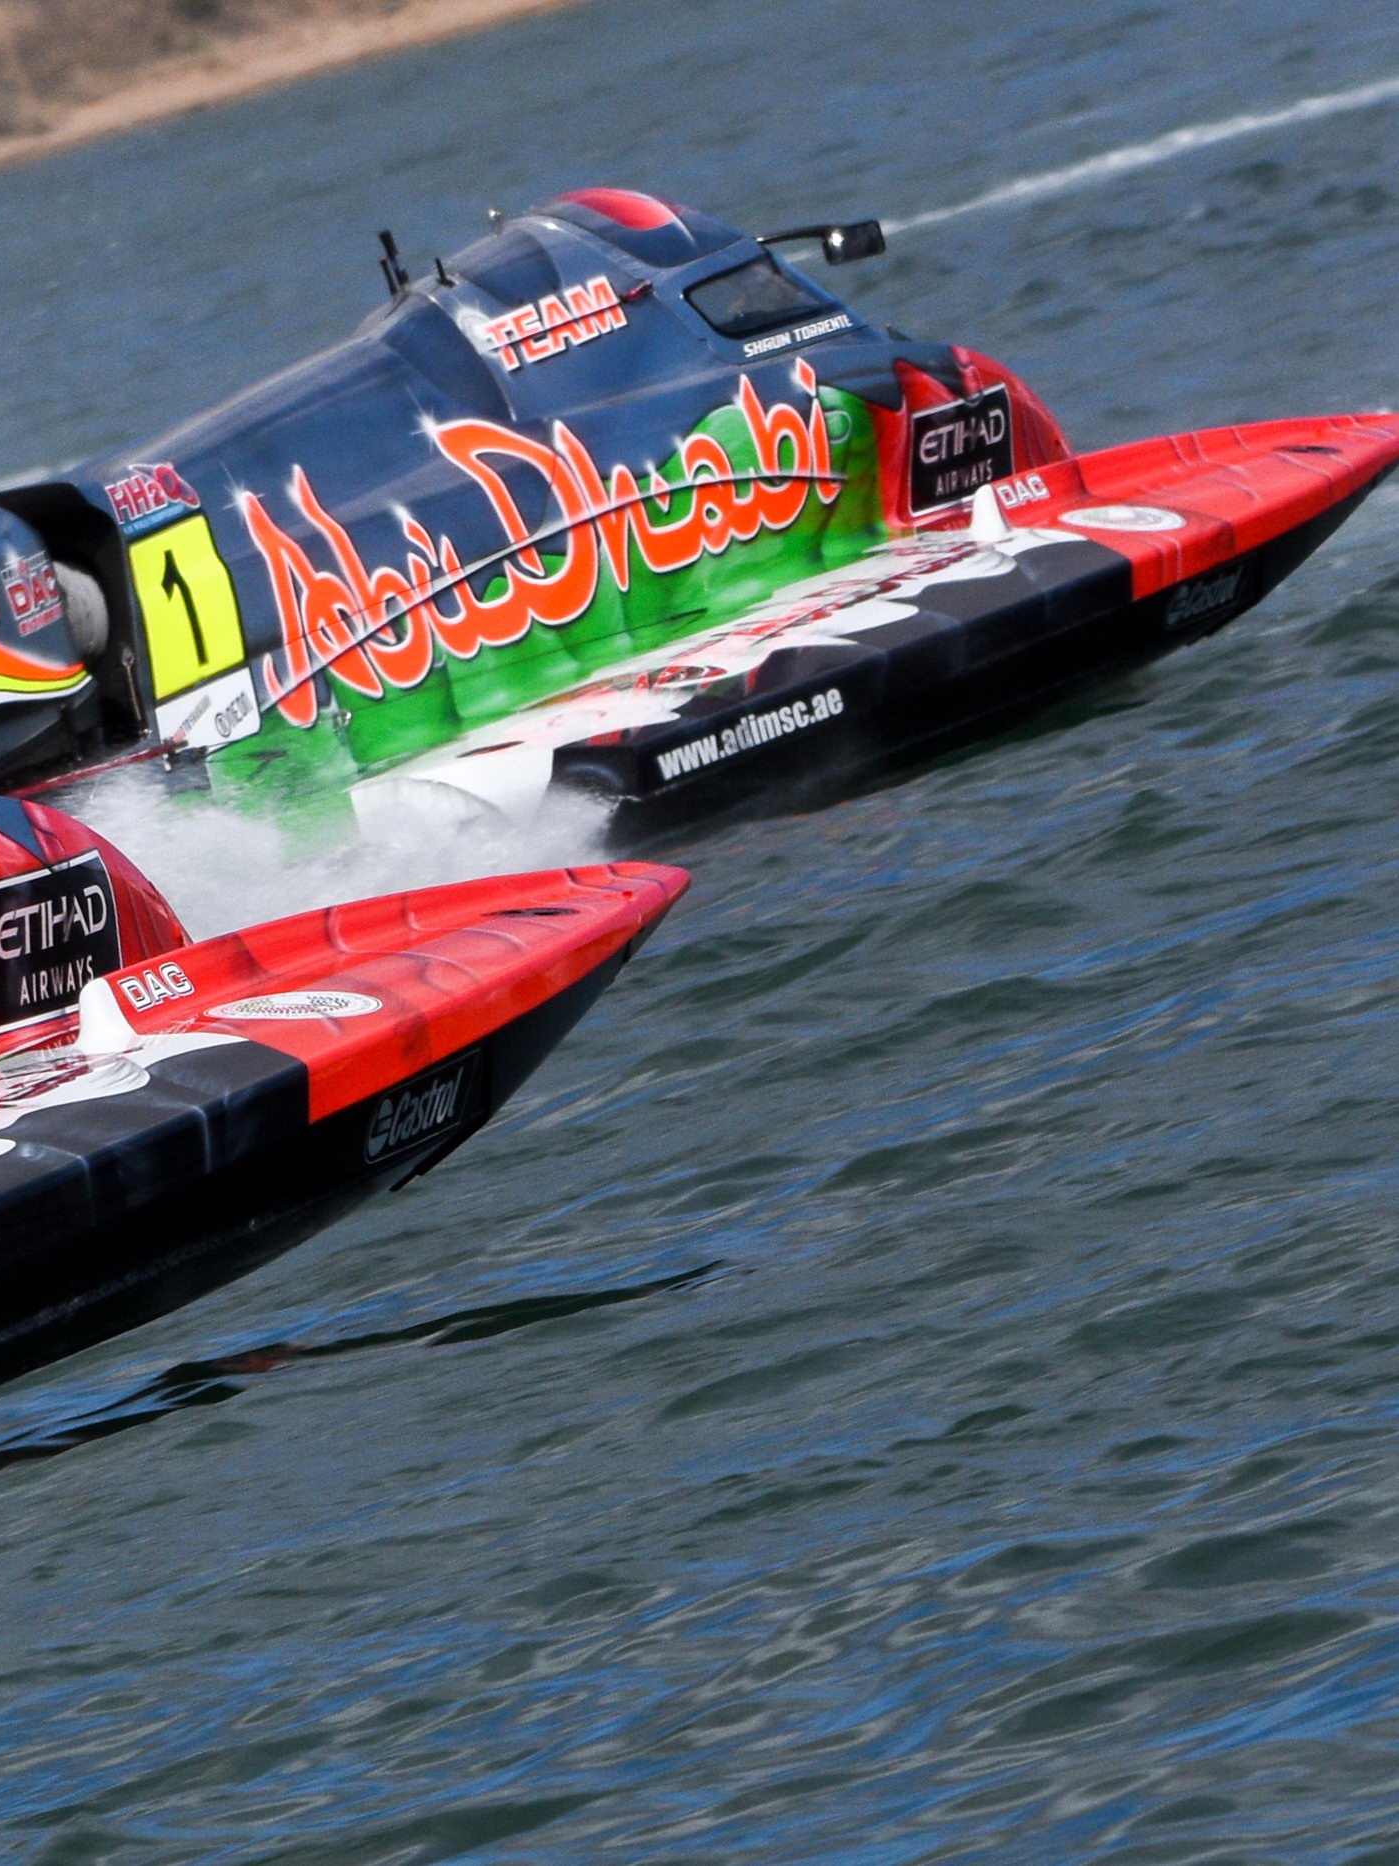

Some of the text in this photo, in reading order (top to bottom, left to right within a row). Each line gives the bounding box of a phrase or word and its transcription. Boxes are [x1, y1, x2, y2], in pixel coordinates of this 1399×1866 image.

[481, 275, 628, 371] TEAM
[743, 313, 853, 358] SHAUN TORRENTE
[918, 408, 1006, 465] ETIHAD
[935, 458, 994, 497] AIRWAYS
[995, 472, 1050, 508] DAC
[242, 357, 843, 728] Abu Dhabi
[161, 548, 209, 667] 1
[657, 687, 845, 781] www.adimsc.ae
[19, 955, 95, 1006] AIRWAYS
[116, 961, 195, 1013] DAC
[388, 1066, 464, 1147] Castrol
